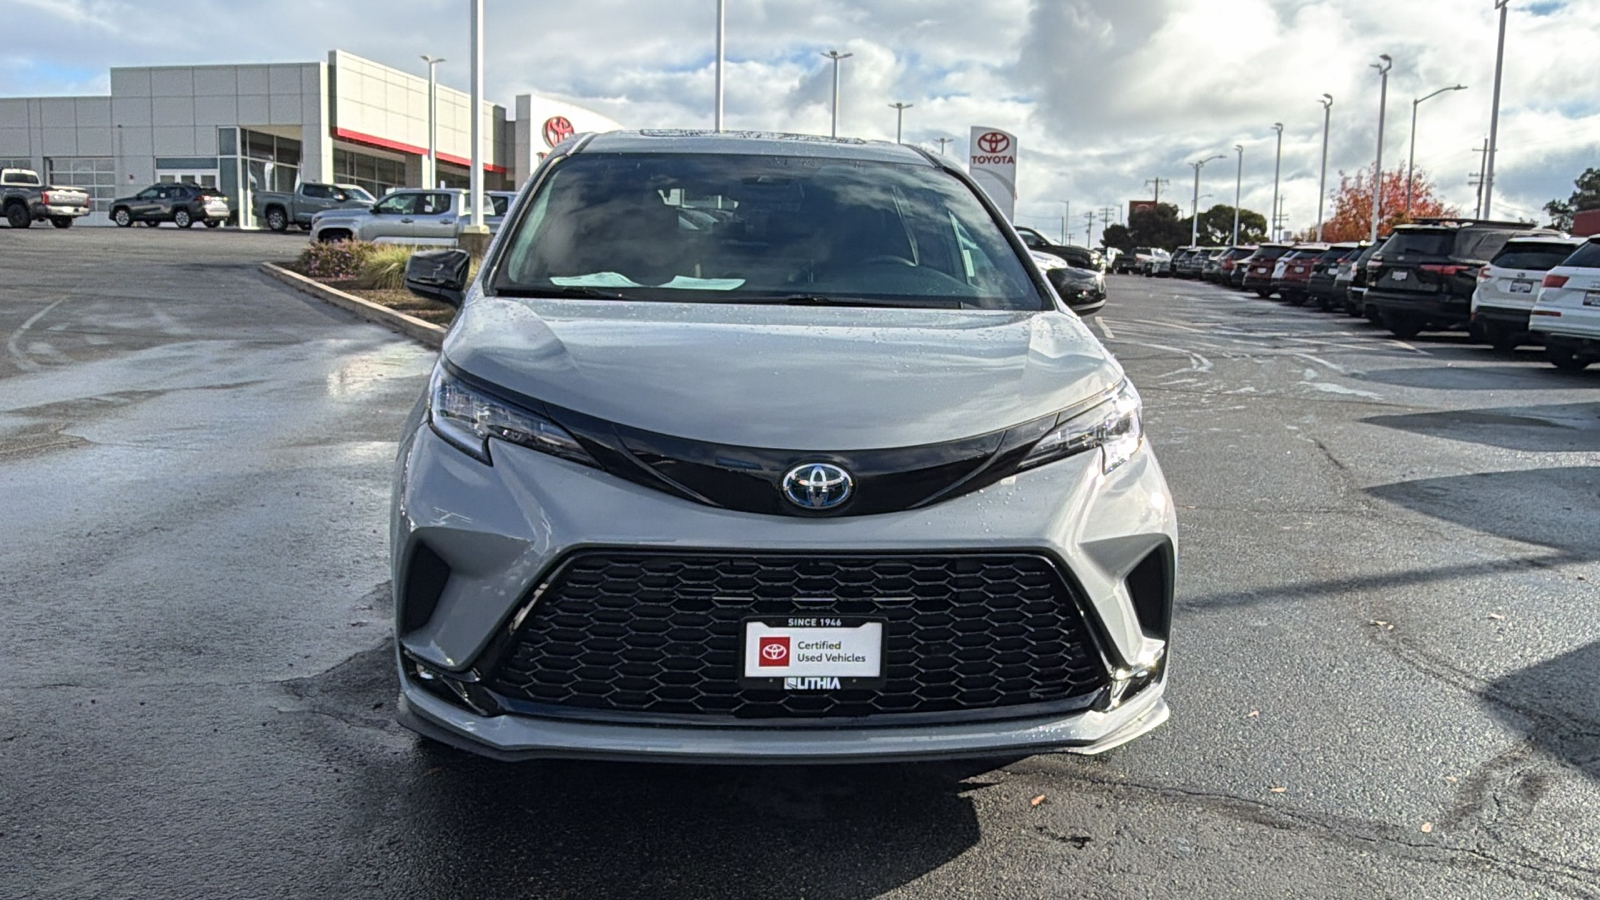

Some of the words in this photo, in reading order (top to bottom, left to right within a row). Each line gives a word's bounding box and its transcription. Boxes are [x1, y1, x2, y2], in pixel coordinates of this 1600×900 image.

[971, 155, 1014, 164] TOYOTA
[788, 618, 817, 627] SINCE
[819, 618, 842, 627] 1946
[797, 641, 842, 650] Certified
[797, 653, 823, 663] Used
[825, 653, 866, 663] Vehicles
[797, 677, 841, 689] LITHIA
